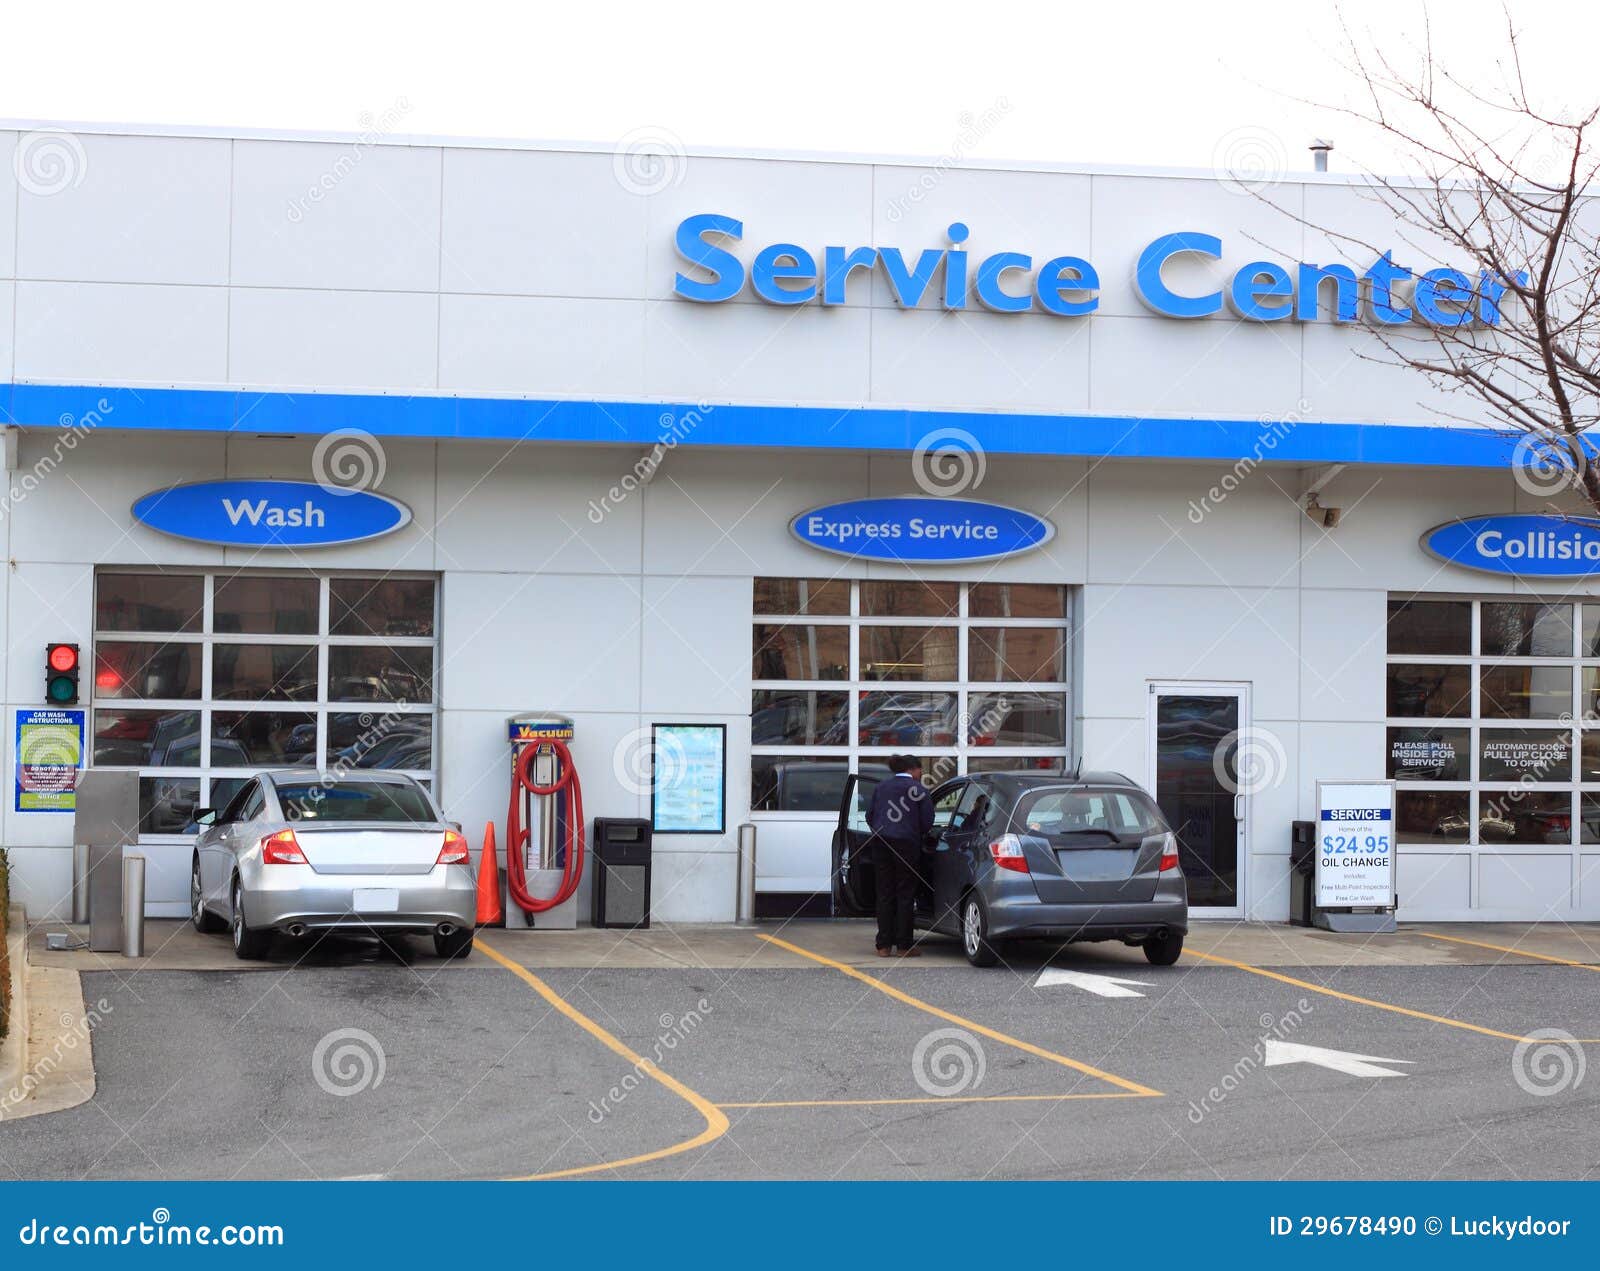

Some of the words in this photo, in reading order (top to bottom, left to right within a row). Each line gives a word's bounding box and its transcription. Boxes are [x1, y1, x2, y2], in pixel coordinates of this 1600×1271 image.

[672, 213, 1100, 316] Service
[1135, 231, 1528, 327] Center
[222, 498, 325, 527] Wash
[808, 516, 901, 542] Express
[909, 518, 999, 539] Service
[1475, 530, 1600, 560] Collisio
[519, 725, 573, 738] Vacuum
[1393, 742, 1429, 750] PLEASE
[1391, 750, 1429, 758] INSIDE
[1431, 751, 1455, 759] FOR
[1483, 751, 1513, 759] PULL
[1514, 751, 1529, 759] UP
[1531, 751, 1568, 760] CLOSE
[1402, 758, 1446, 767] SERVICE
[1519, 760, 1548, 768] OPEN
[1330, 809, 1381, 820] SERVICE
[1323, 835, 1389, 856] $24.95
[1321, 858, 1340, 867] OIL
[1342, 857, 1389, 867] CHANGE
